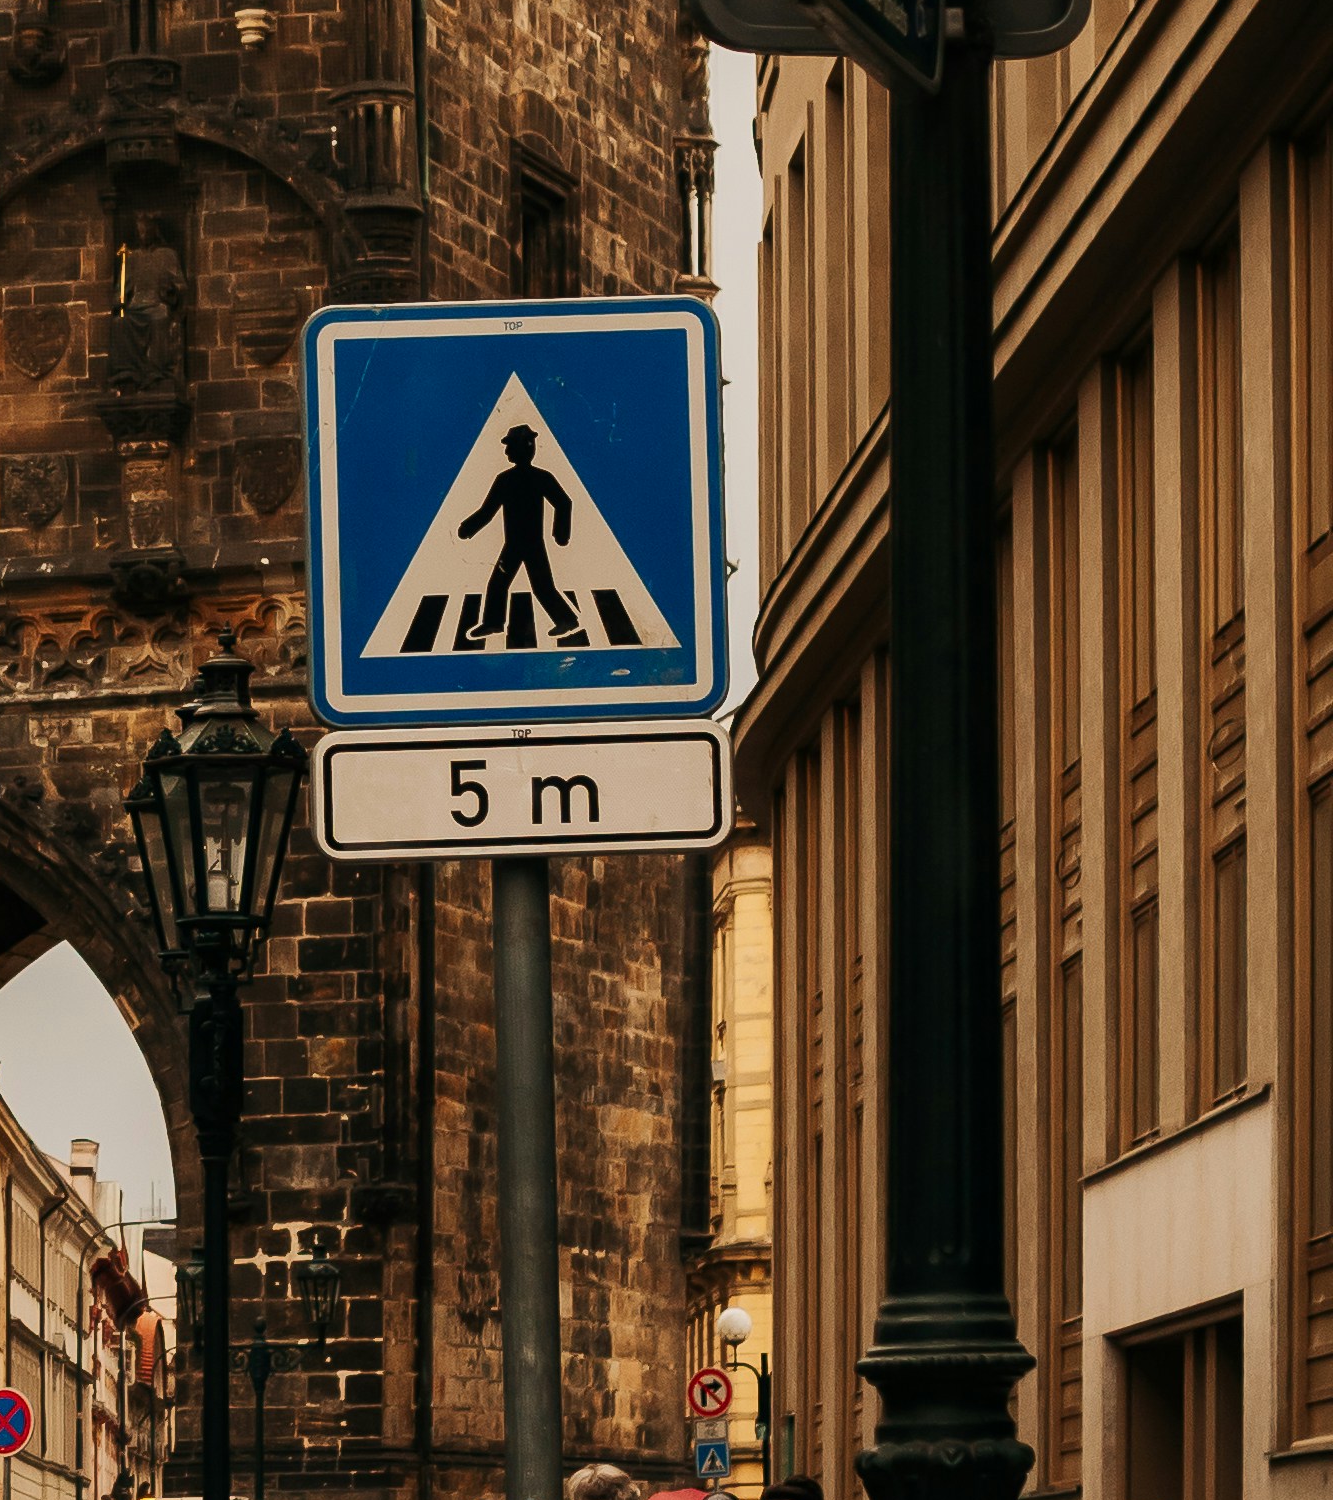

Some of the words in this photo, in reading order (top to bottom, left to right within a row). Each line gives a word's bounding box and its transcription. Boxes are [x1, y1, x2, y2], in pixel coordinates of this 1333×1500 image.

[504, 321, 523, 331] TOP
[450, 760, 489, 828] 5
[531, 773, 600, 825] m
